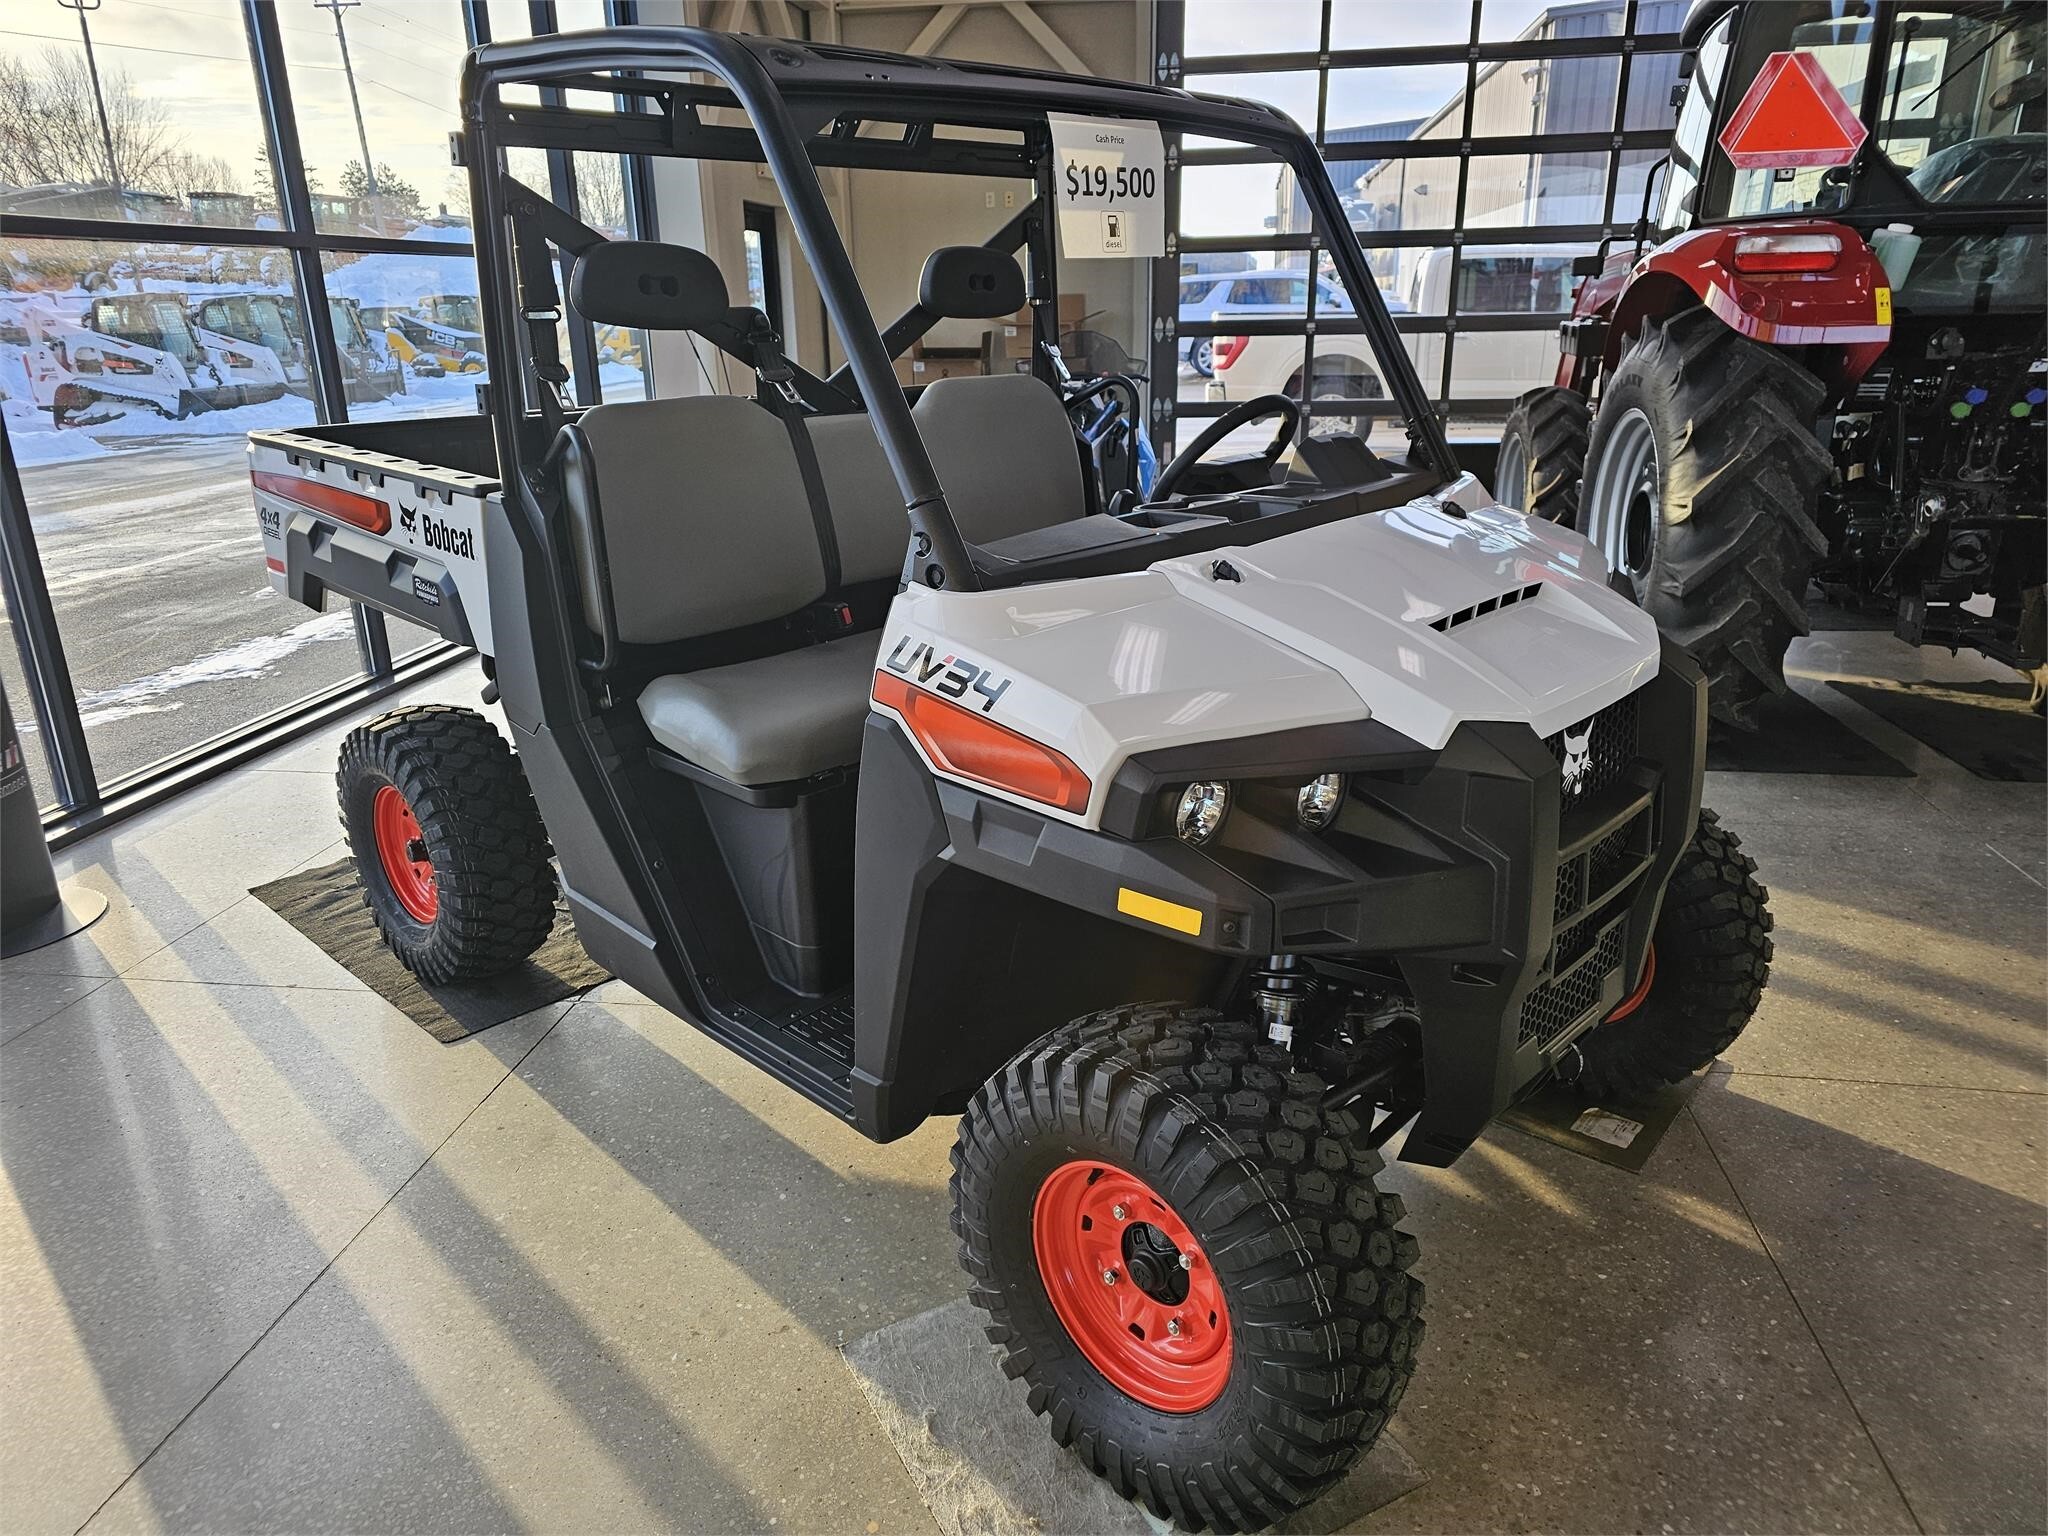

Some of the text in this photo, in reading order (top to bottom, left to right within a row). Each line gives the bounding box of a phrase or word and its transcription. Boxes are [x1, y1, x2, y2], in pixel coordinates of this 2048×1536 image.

[1095, 134, 1125, 145] Cash Price
[1066, 159, 1155, 203] $19,500
[1105, 239, 1122, 249] diesel
[426, 329, 456, 345] JCB
[260, 507, 281, 529] 4x4
[422, 513, 475, 561] Bobcat
[886, 634, 1012, 713] UV34
